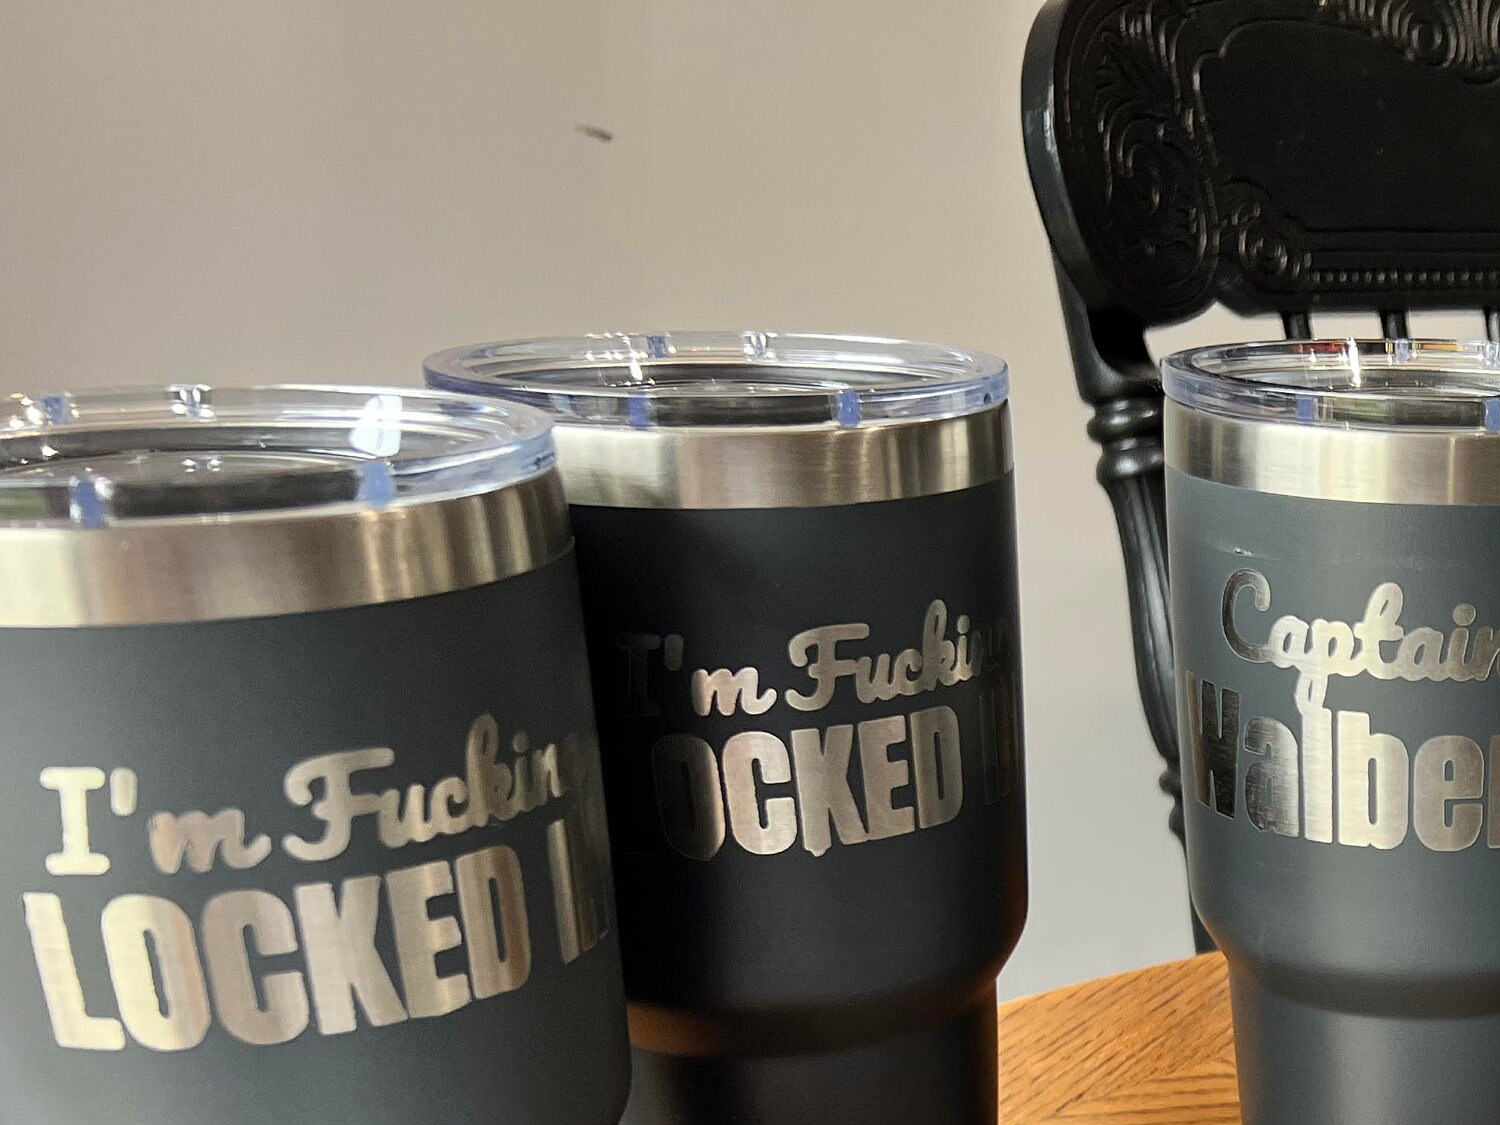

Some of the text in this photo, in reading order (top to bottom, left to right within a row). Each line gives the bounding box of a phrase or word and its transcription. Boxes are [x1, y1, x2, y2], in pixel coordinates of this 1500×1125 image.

[39, 766, 272, 876] I'm
[651, 705, 964, 862] OCKED
[22, 845, 532, 1052] LOCKED
